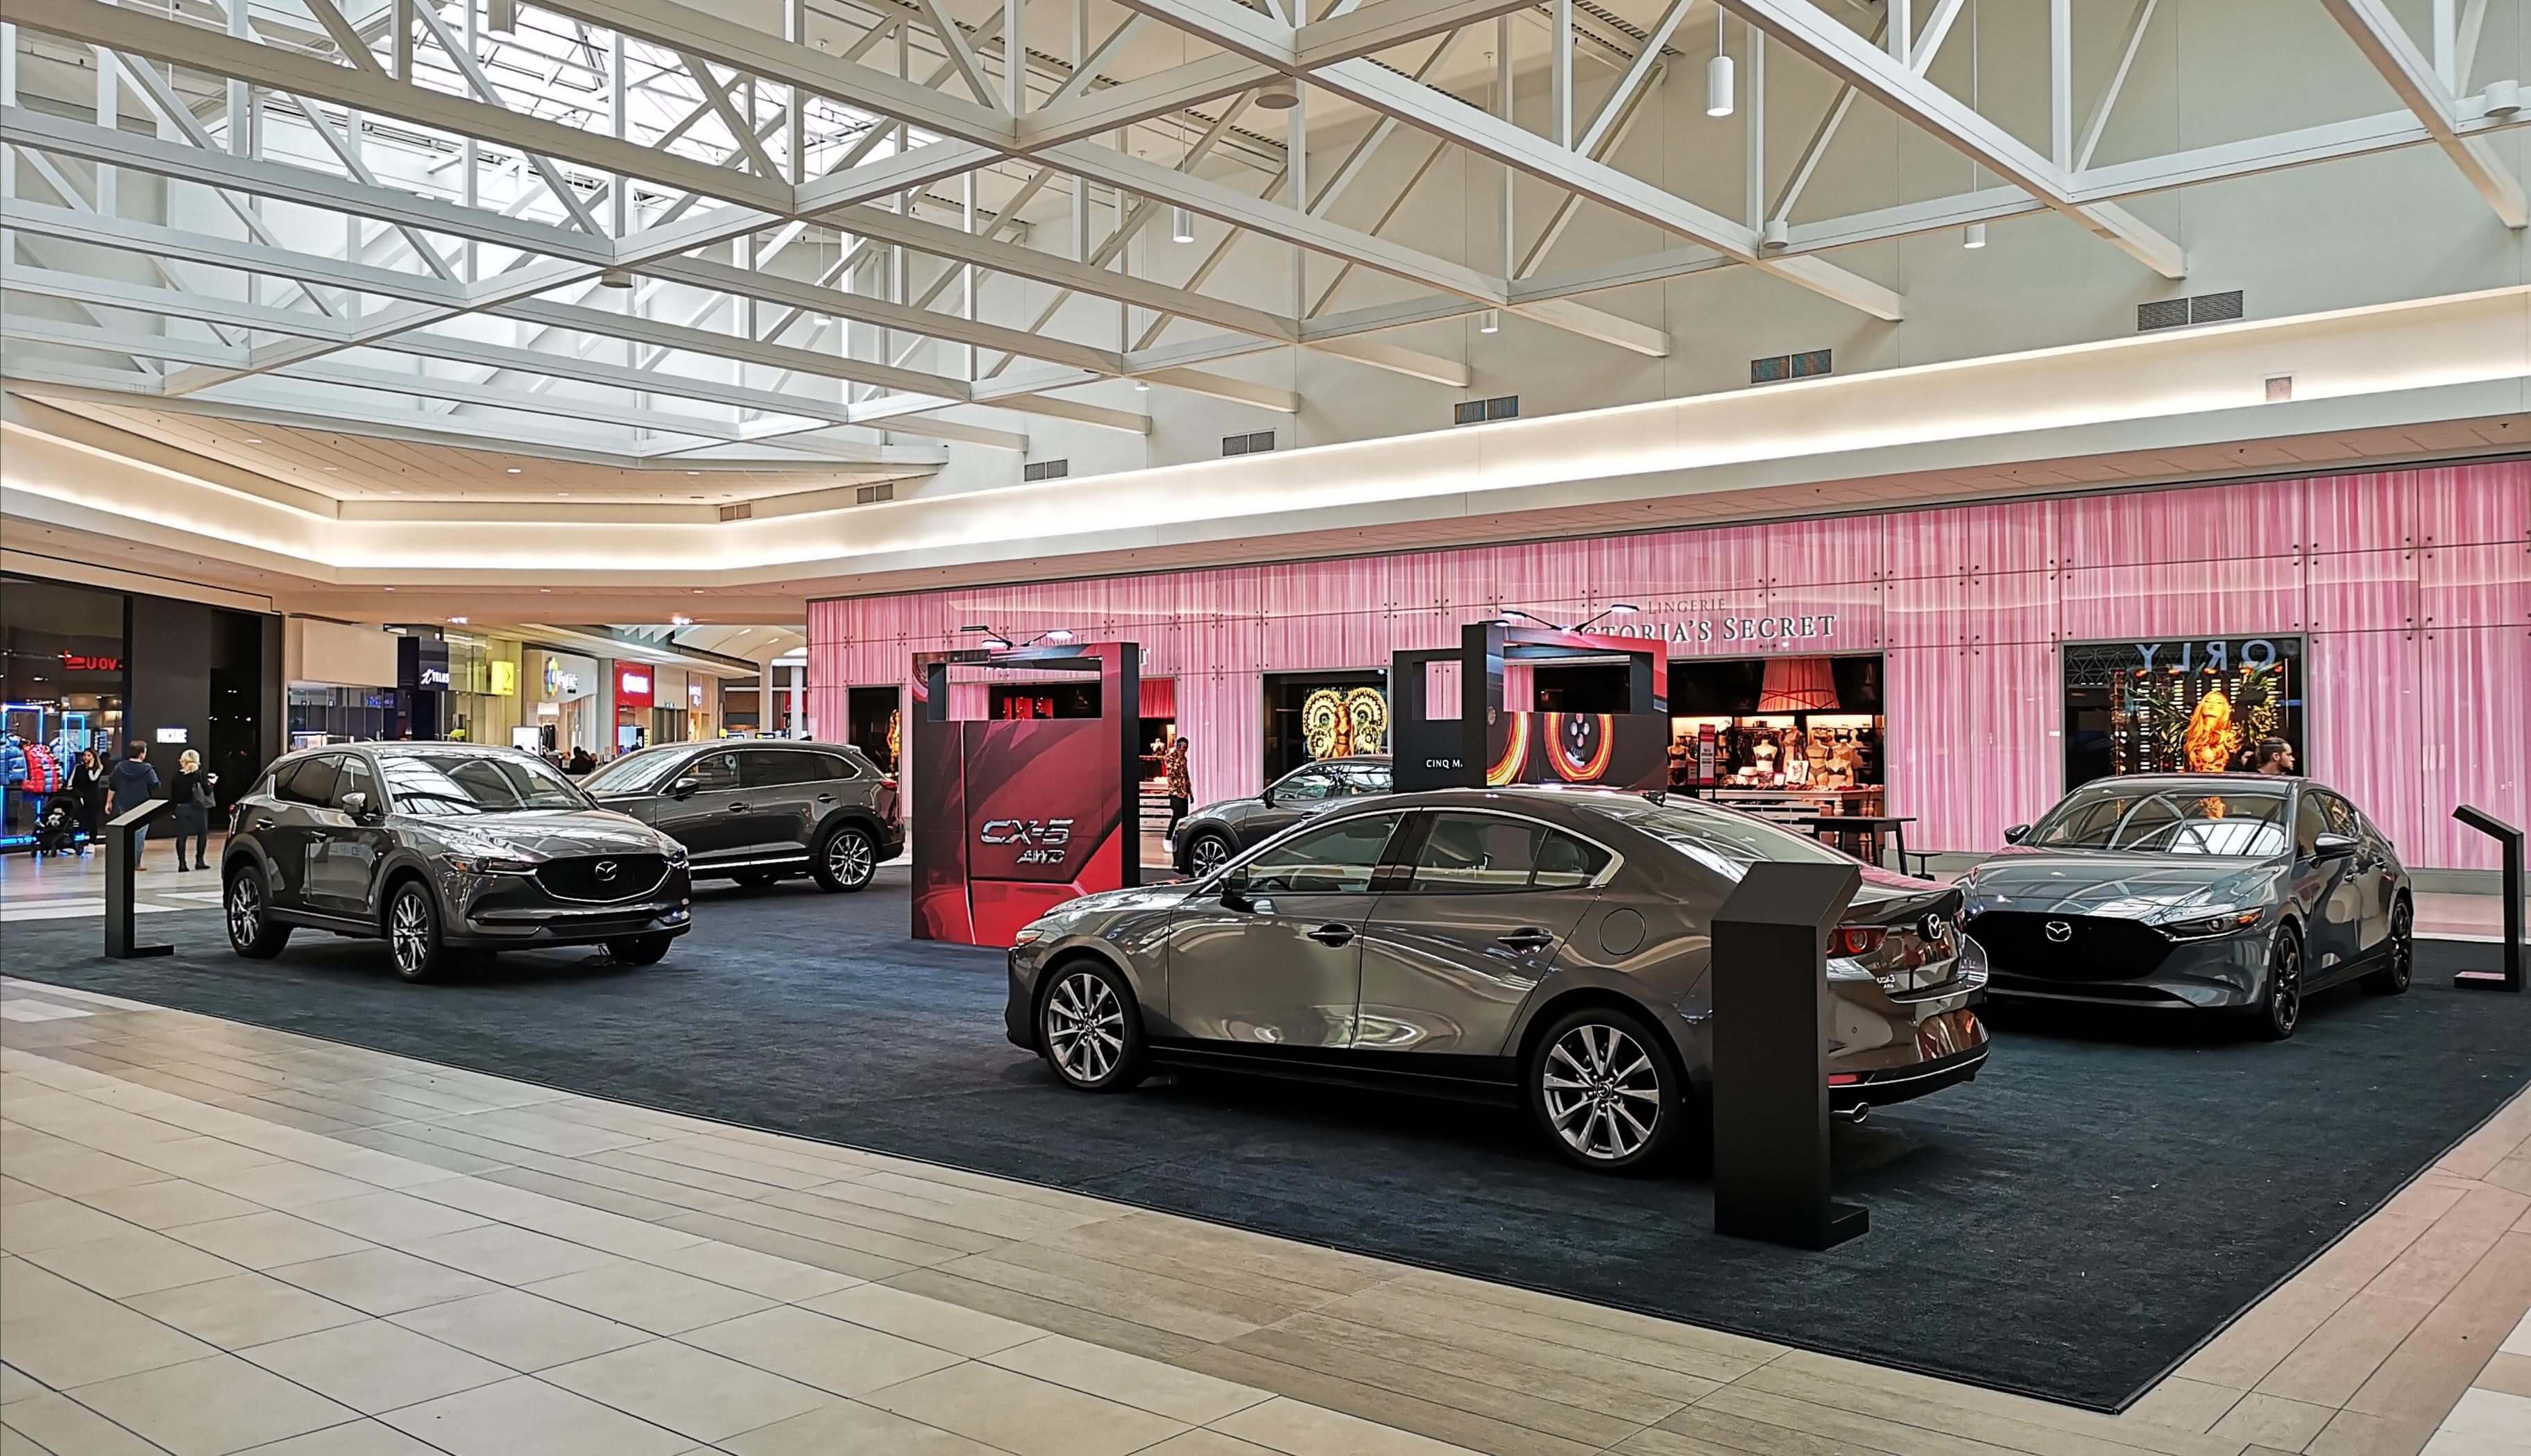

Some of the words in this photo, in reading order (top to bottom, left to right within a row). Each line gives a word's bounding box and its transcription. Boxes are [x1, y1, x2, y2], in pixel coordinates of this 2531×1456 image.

[1648, 599, 1725, 615] LINGERIE
[1723, 615, 1835, 641] SECRET
[1426, 759, 1449, 769] CINQ
[1452, 759, 1463, 768] M
[980, 819, 1074, 845] CX-5
[1016, 849, 1066, 864] AWD
